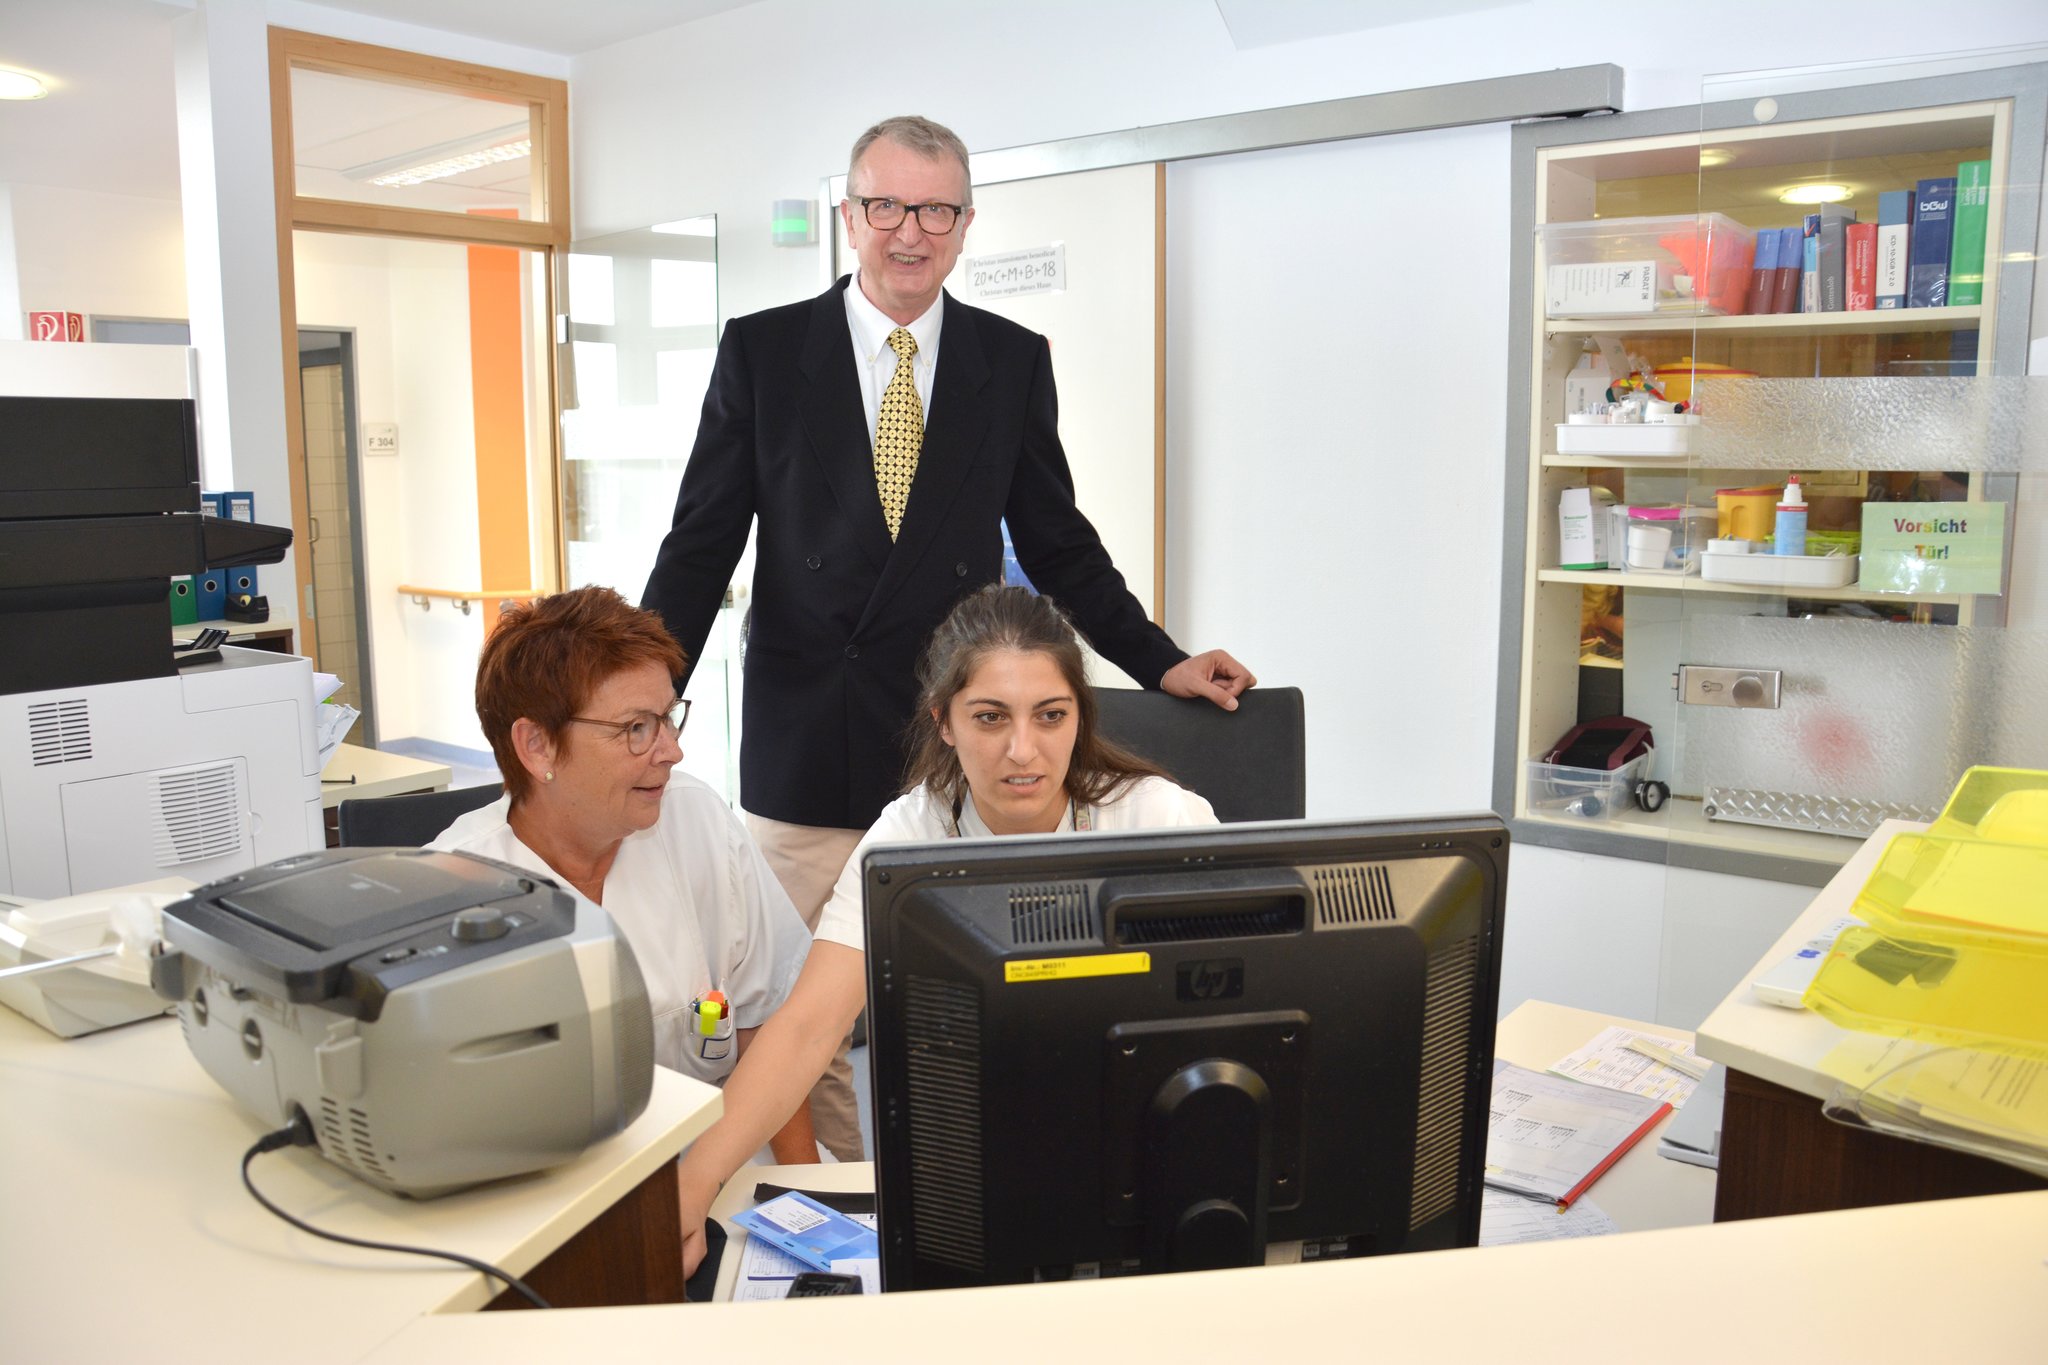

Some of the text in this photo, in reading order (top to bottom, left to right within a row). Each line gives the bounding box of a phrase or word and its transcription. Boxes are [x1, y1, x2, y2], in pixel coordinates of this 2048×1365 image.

[1826, 275, 1835, 310] Gotteslob
[368, 437, 394, 447] F 304
[1893, 518, 1968, 534] Vorsicht
[1914, 544, 1949, 560] Tür!
